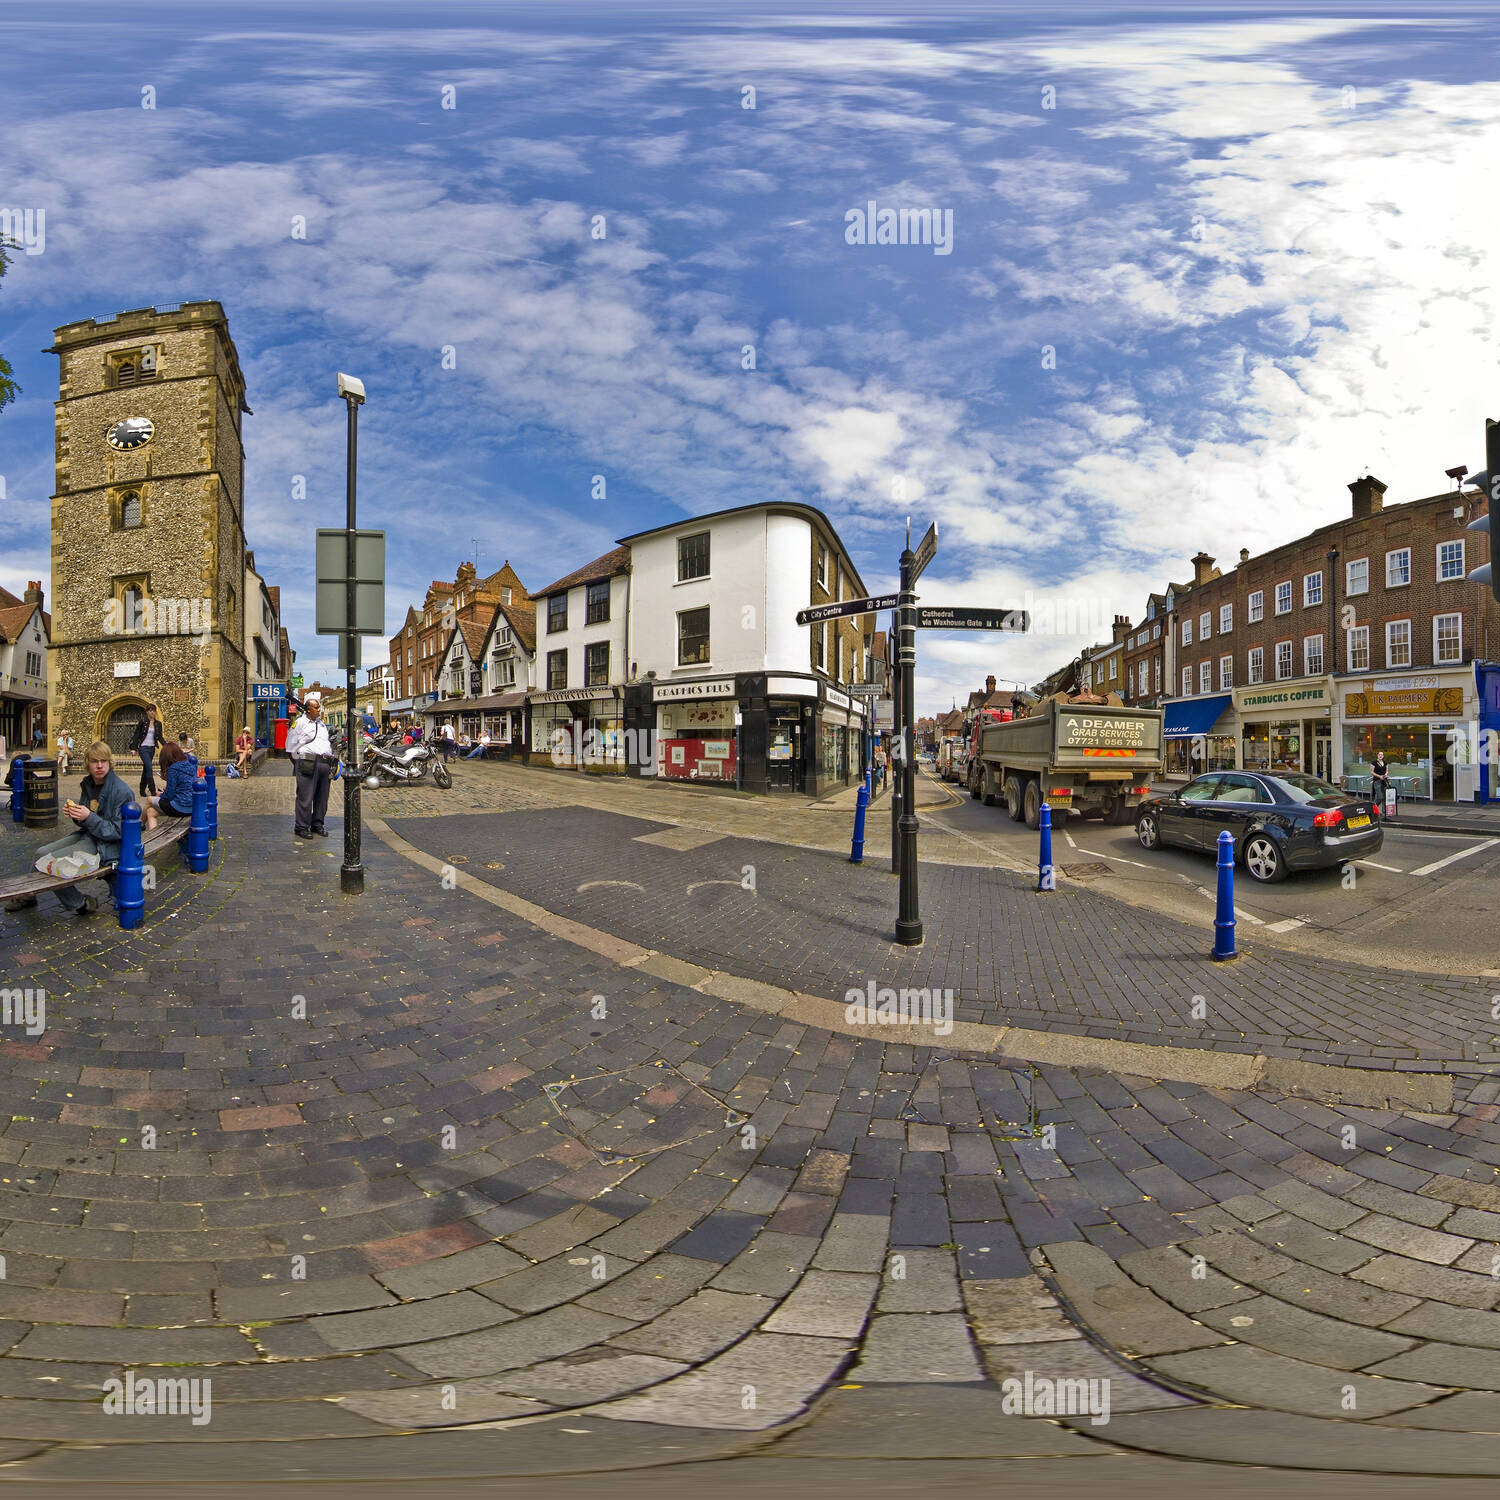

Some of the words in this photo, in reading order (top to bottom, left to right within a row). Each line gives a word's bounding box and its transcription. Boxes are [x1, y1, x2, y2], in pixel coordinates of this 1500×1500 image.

[811, 610, 822, 619] City
[823, 607, 842, 616] Centre
[881, 598, 896, 607] mins
[922, 610, 954, 618] Cathedral
[933, 619, 965, 627] Waxhouse
[1412, 676, 1437, 688] £2.99
[257, 685, 280, 696] isis
[657, 684, 703, 697] GRAPHICS
[706, 683, 730, 694] PLUS
[1244, 693, 1288, 706] STARBUCKS
[1290, 690, 1324, 700] COFFEE
[1388, 693, 1428, 703] PALMERS
[1066, 719, 1078, 728] A
[1082, 720, 1145, 730] DEAMER
[1072, 728, 1098, 737] GRAB
[1100, 729, 1140, 739] SERVICES
[1104, 738, 1122, 746] 056
